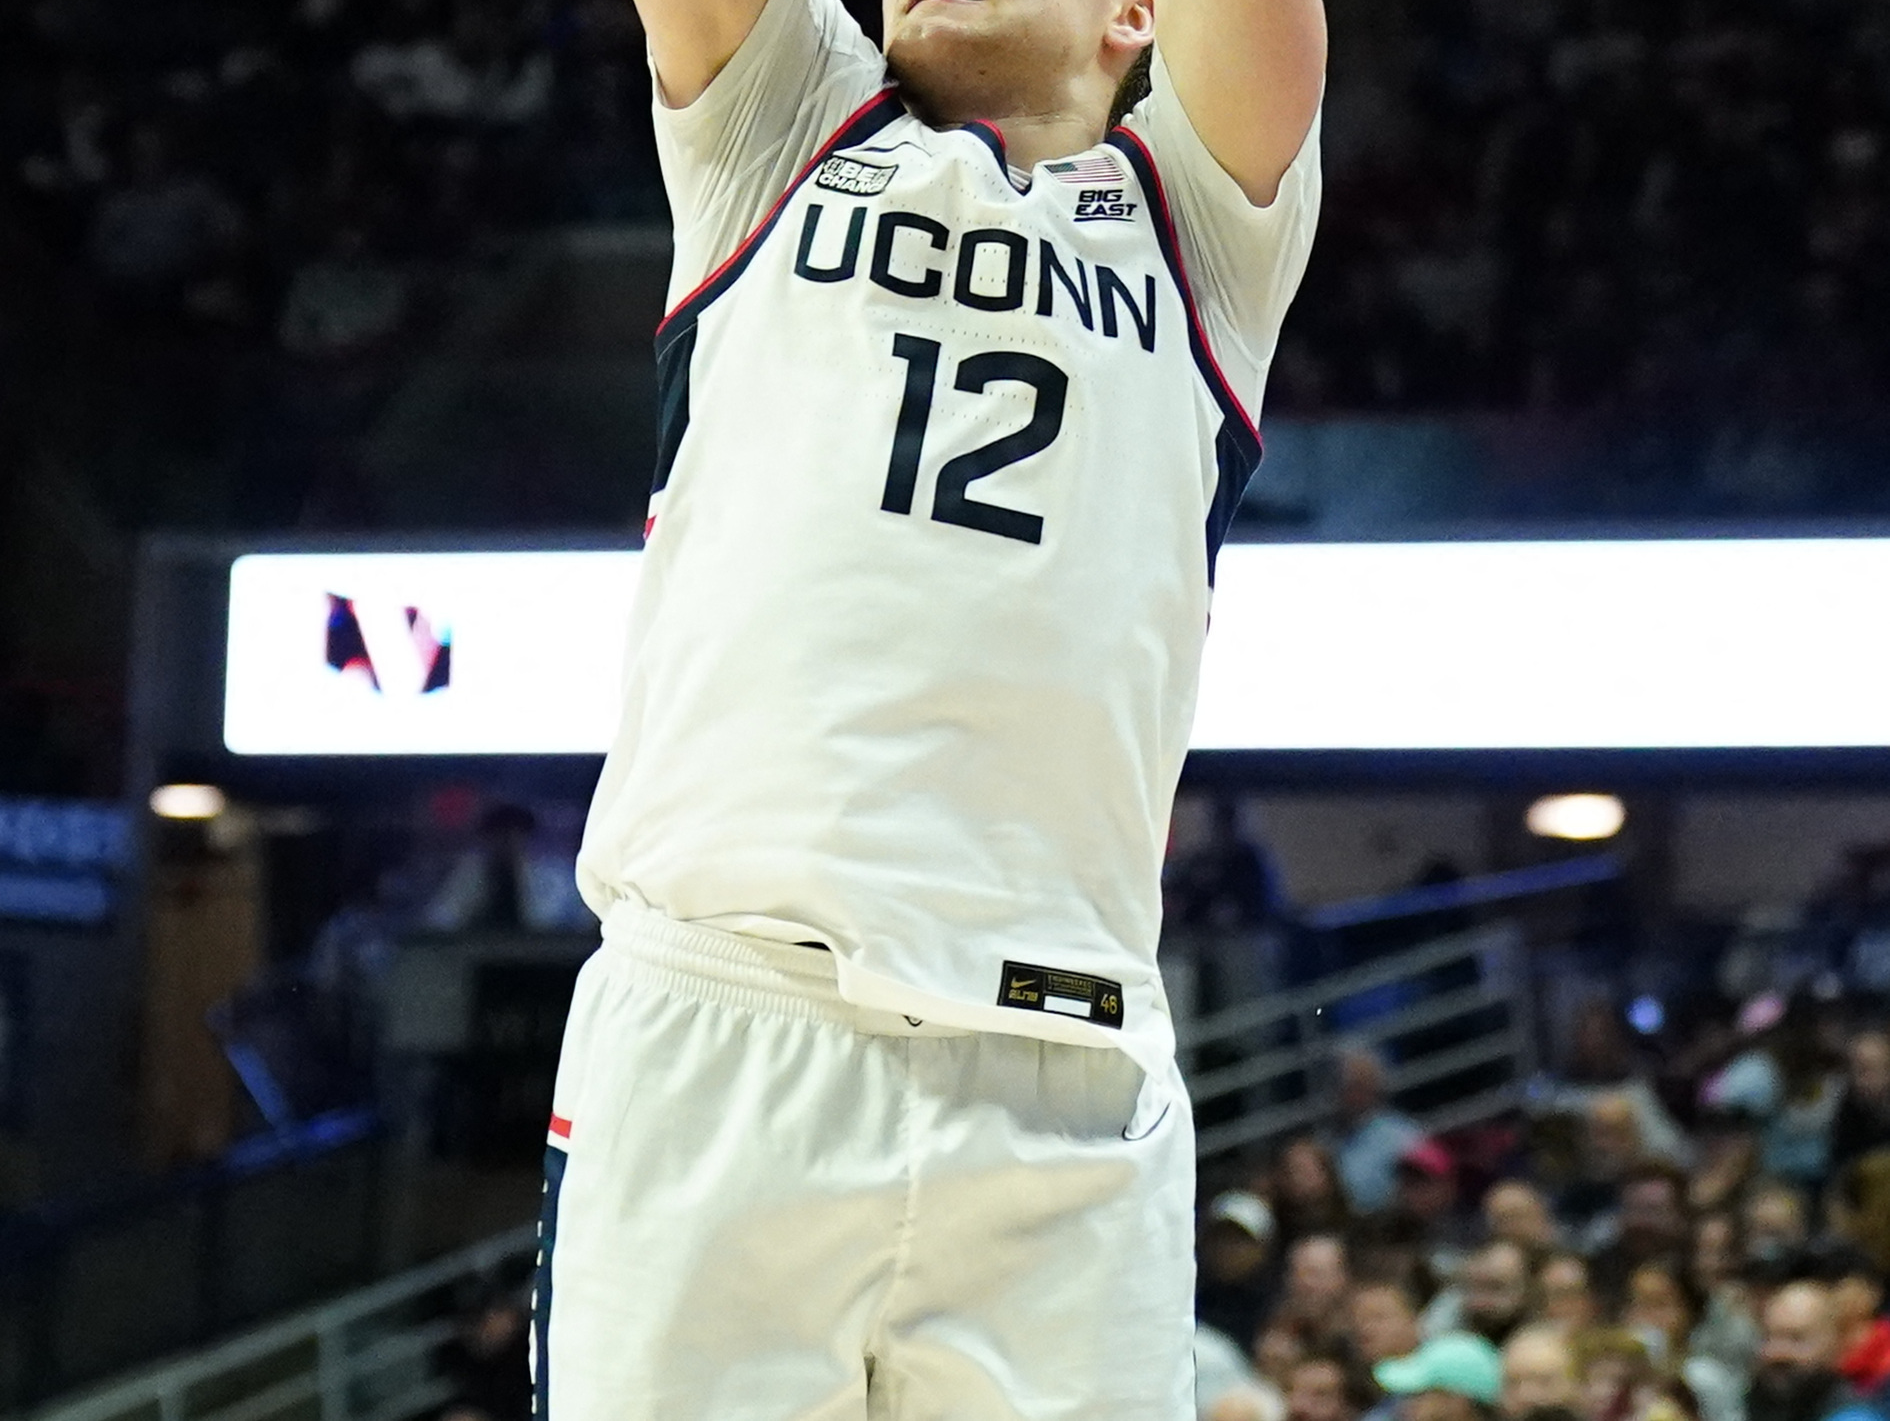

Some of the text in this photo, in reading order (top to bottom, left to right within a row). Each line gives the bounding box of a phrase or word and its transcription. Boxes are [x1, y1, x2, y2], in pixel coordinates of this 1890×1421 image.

[1075, 204, 1137, 216] EAST
[1079, 189, 1123, 203] BIG
[794, 203, 1156, 354] UCONN
[881, 332, 1069, 545] 12
